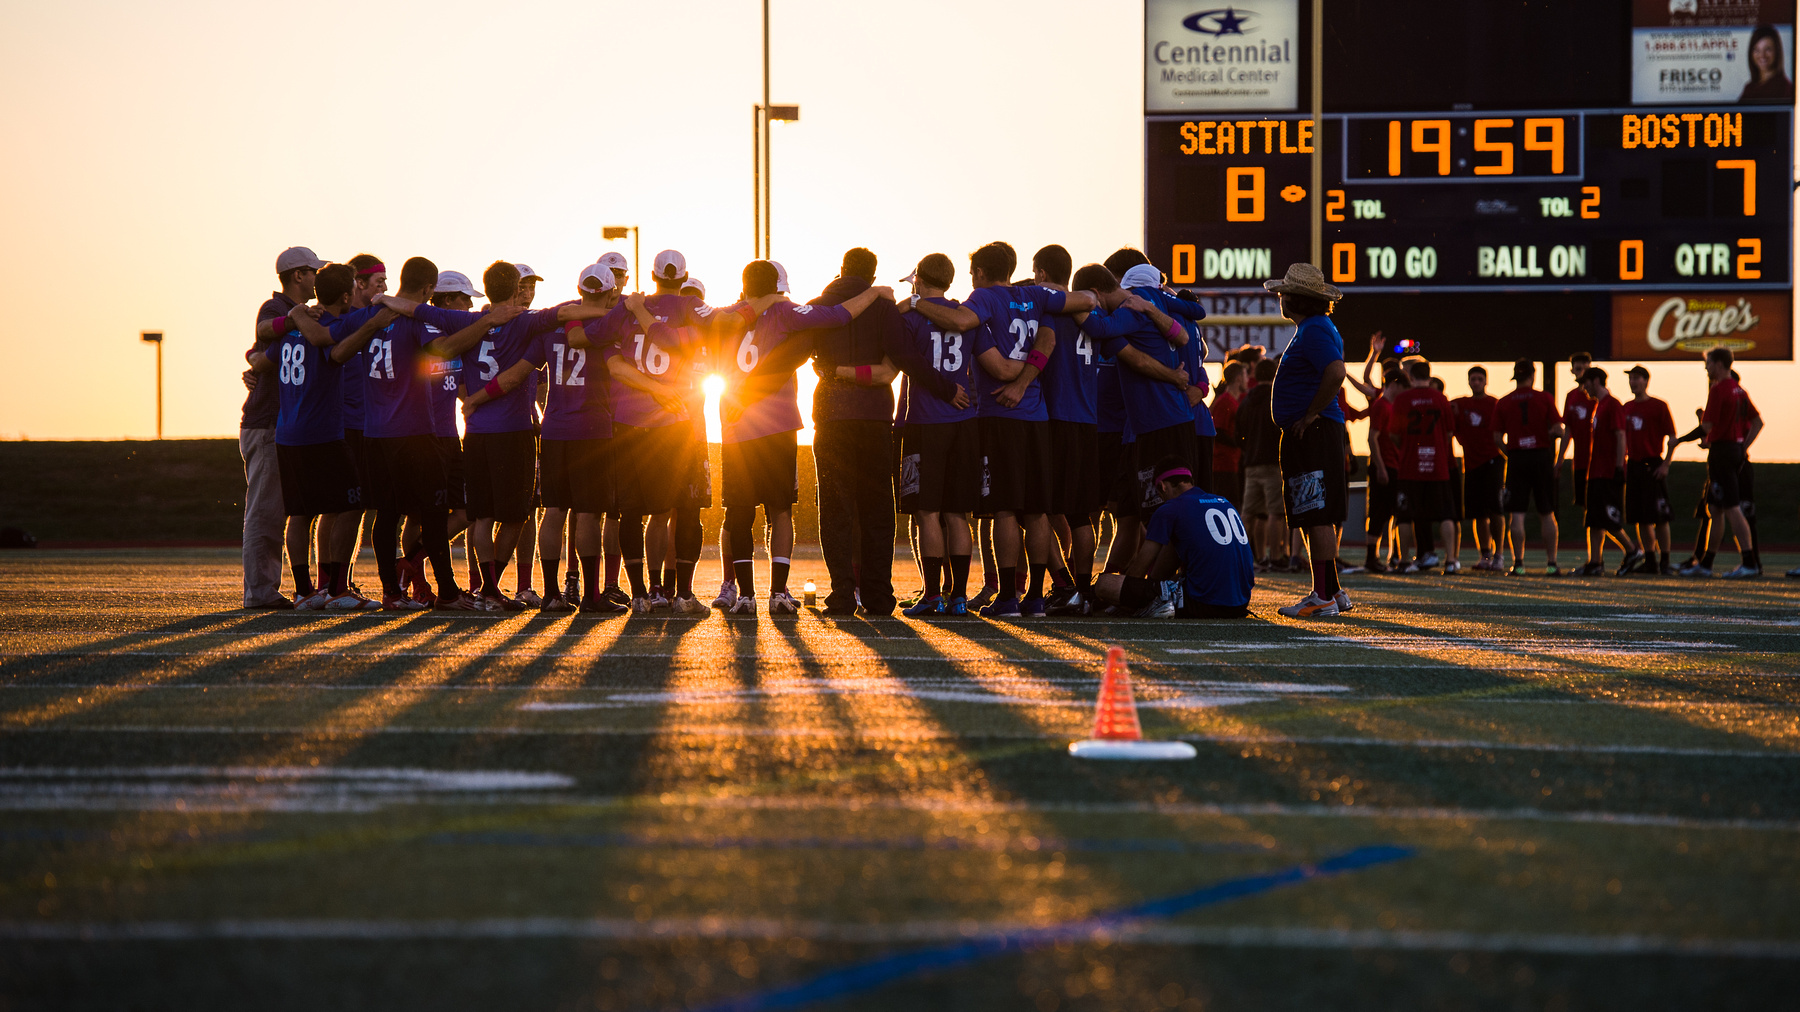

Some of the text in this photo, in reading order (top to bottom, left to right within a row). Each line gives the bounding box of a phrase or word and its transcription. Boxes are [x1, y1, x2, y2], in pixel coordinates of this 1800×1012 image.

[1154, 39, 1290, 65] Centennial
[1160, 67, 1279, 84] Medical Center
[1660, 68, 1721, 84] FRISCO
[1180, 120, 1315, 155] SEATTLE
[1388, 118, 1565, 176] 19:59
[1622, 113, 1742, 149] BOSTON
[1226, 166, 1265, 222] 8
[1325, 189, 1385, 222] 2 TOL
[1540, 197, 1574, 217] TOL
[1581, 186, 1600, 219] 2
[1716, 159, 1756, 216] 7
[1172, 244, 1272, 284] 0 DOWN
[1332, 243, 1438, 282] 0 TO GO
[1477, 240, 1644, 280] BALL ON 0
[1674, 238, 1761, 279] QTR 2
[1647, 297, 1759, 350] Cane's
[280, 342, 306, 386] 88
[368, 338, 395, 379] 21
[477, 340, 500, 381] 5
[553, 343, 586, 386] 12
[634, 334, 670, 375] 16
[736, 330, 759, 373] 6
[930, 331, 963, 372] 13
[1076, 330, 1093, 365] 4
[443, 375, 457, 391] 38
[1406, 410, 1441, 435] 27
[1204, 507, 1248, 546] 00
